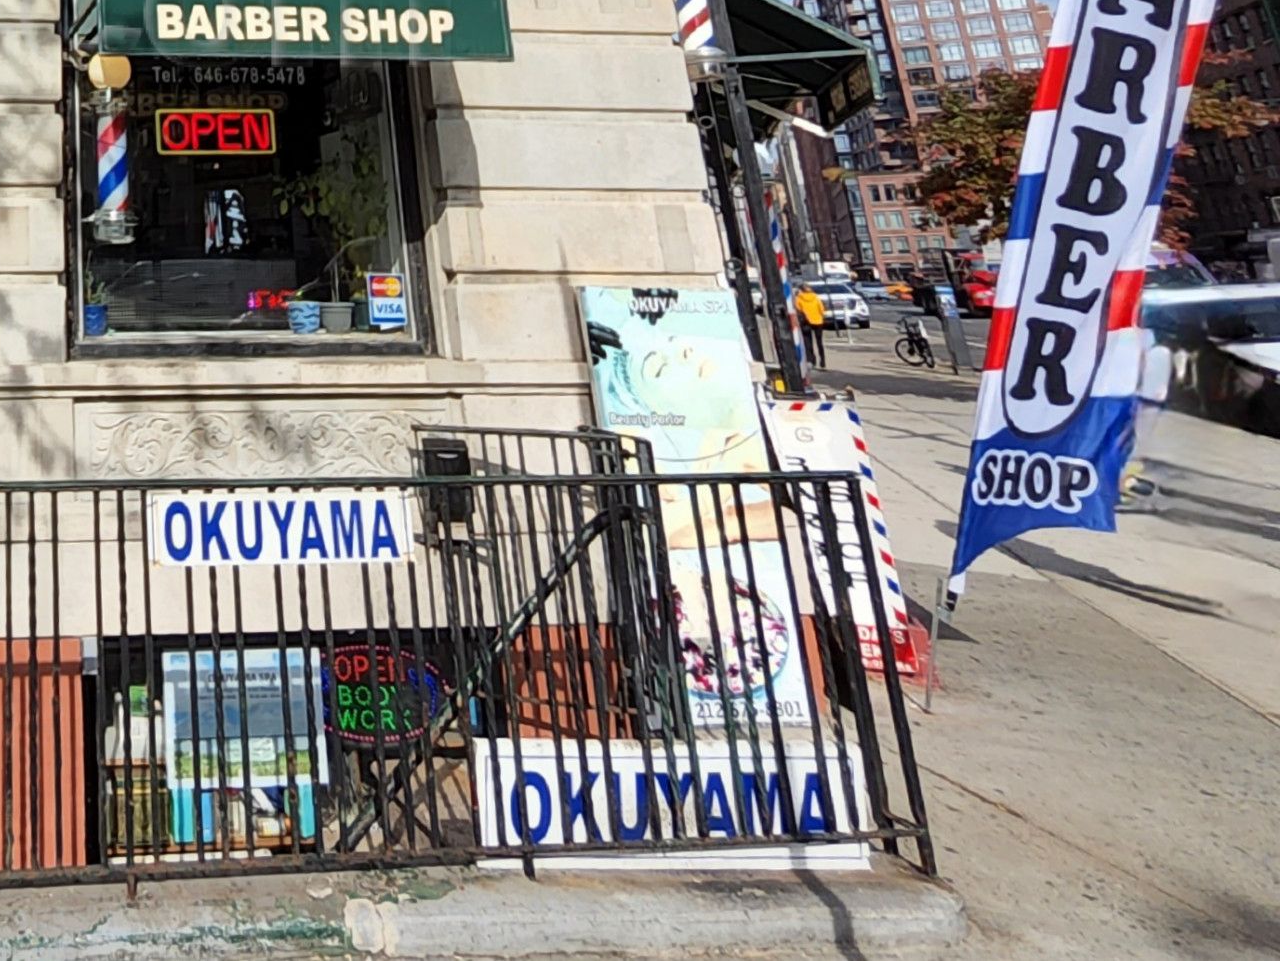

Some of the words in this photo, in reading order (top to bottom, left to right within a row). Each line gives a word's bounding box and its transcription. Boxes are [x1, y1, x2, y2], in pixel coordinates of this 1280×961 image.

[156, 3, 330, 43] BARBER
[342, 6, 456, 45] SHOP
[152, 66, 182, 84] Tel.
[160, 113, 271, 151] OPEN
[376, 303, 404, 314] VISA
[609, 412, 650, 427] Beauty
[977, 452, 1094, 510] SHOP
[164, 499, 400, 562] OKUYAMA
[337, 684, 405, 707] BOD
[511, 770, 833, 844] OKUYAMA
